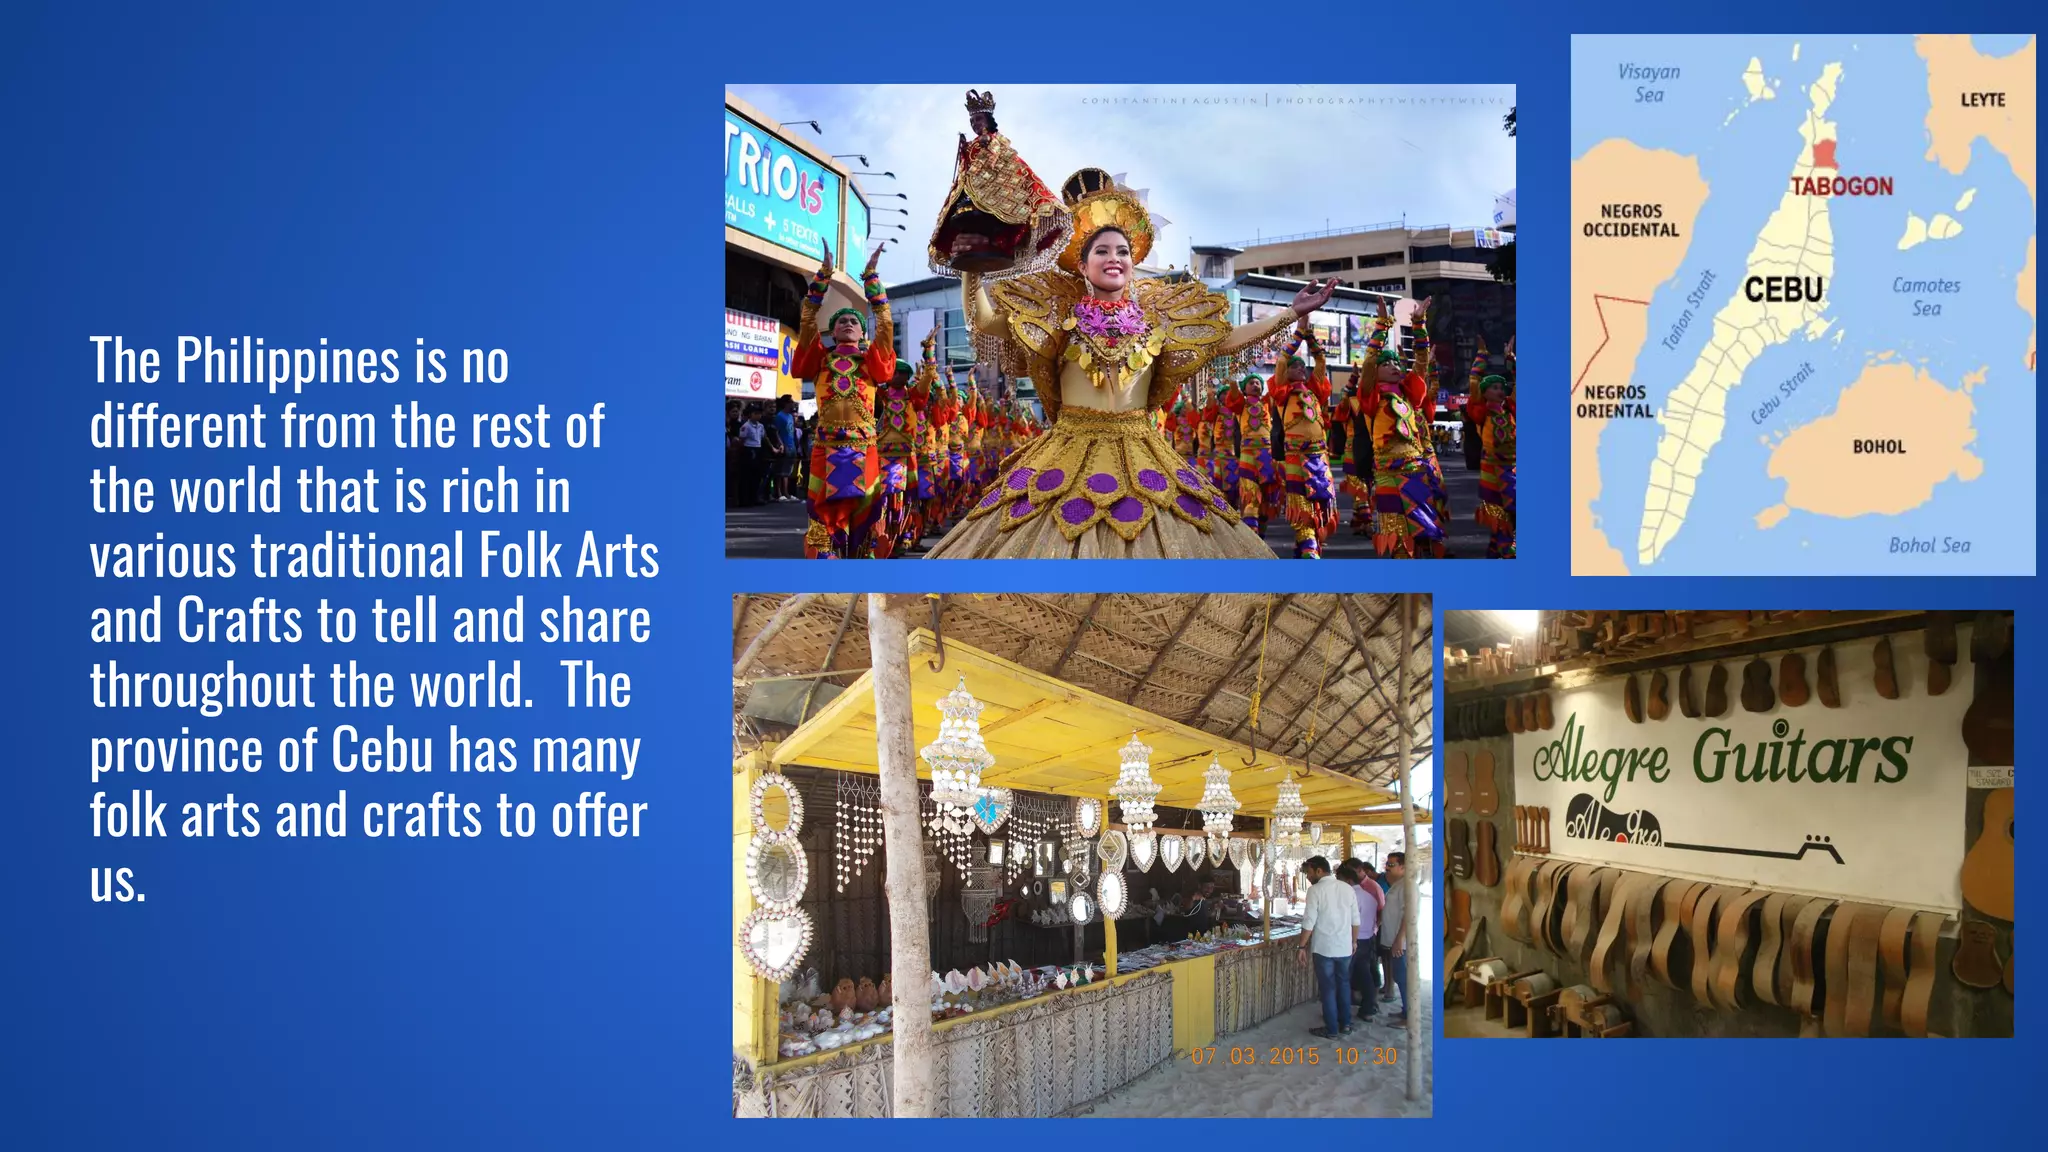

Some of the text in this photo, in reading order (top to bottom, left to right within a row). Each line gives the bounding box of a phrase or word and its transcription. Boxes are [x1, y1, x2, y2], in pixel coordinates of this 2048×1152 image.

[1619, 63, 1680, 82] Visayan
[1635, 86, 1664, 103] Sea
[1961, 93, 2006, 107] LEYTE
[1791, 176, 1894, 196] TABOGON
[725, 191, 756, 218] ALLS
[1601, 204, 1662, 219] NEGROS
[1583, 223, 1680, 237] OCCIDENTAL
[1745, 276, 1823, 302] CEBU
[1893, 277, 1961, 293] Camotes
[1662, 268, 1717, 351] Tañon Strait
[1912, 300, 1942, 316] Sea
[743, 344, 769, 355] LOANS
[1585, 385, 1646, 399] NEGROS
[1752, 361, 1816, 425] Cebu Strait
[1577, 404, 1654, 418] ORIENTAL
[1853, 439, 1906, 454] BOHOL
[1889, 537, 1971, 553] Bohol Sea
[1533, 711, 1914, 803] Alegre Guitars
